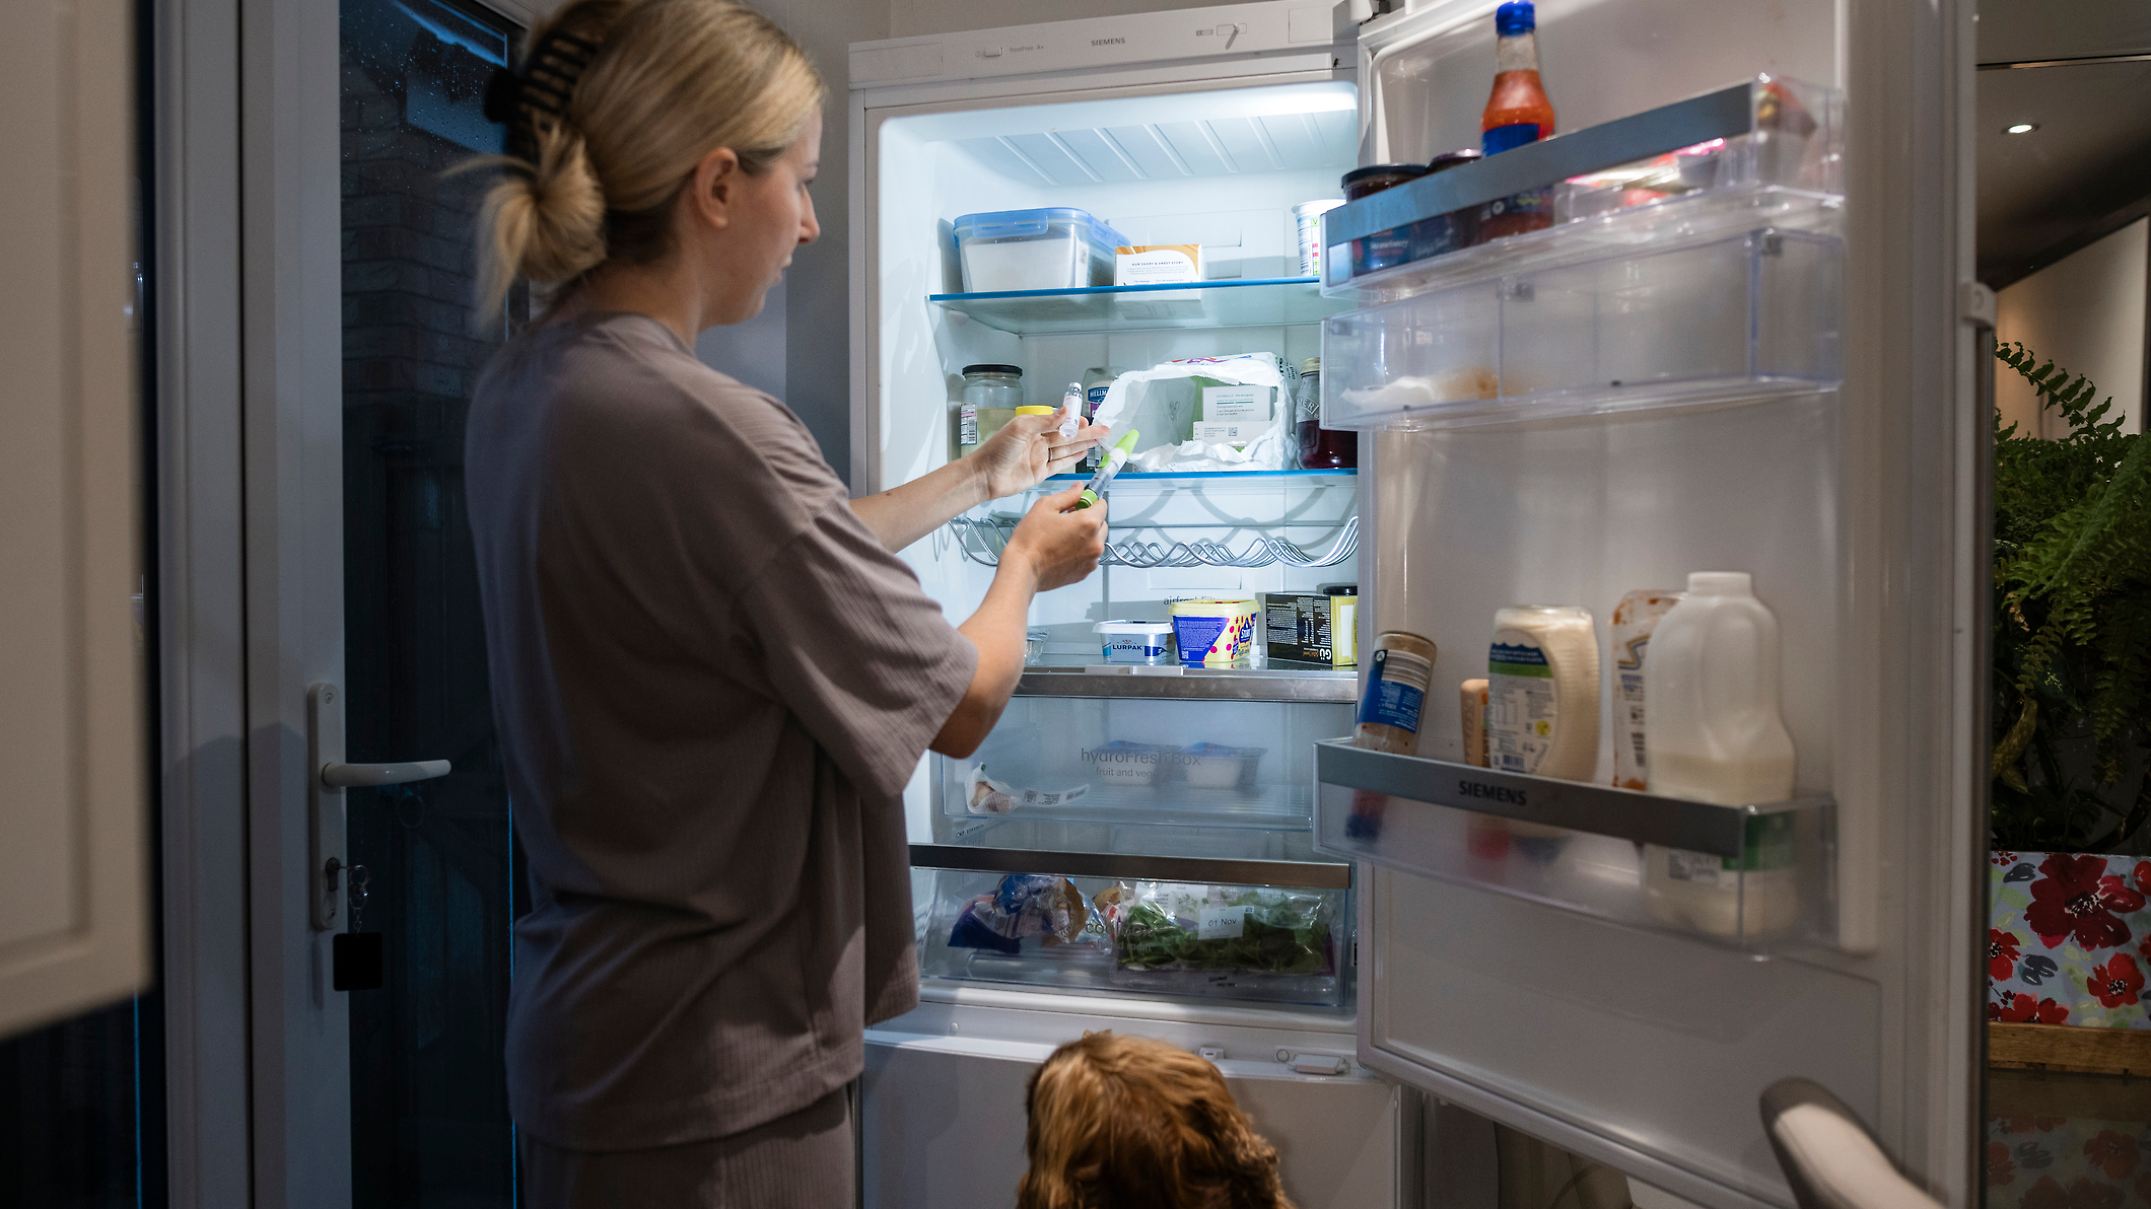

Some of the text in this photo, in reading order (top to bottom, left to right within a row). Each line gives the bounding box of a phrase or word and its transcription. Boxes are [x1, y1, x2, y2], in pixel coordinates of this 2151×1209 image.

[1090, 37, 1126, 47] SIEMENS
[1116, 768, 1133, 777] and
[1458, 780, 1528, 806] SIEMENS
